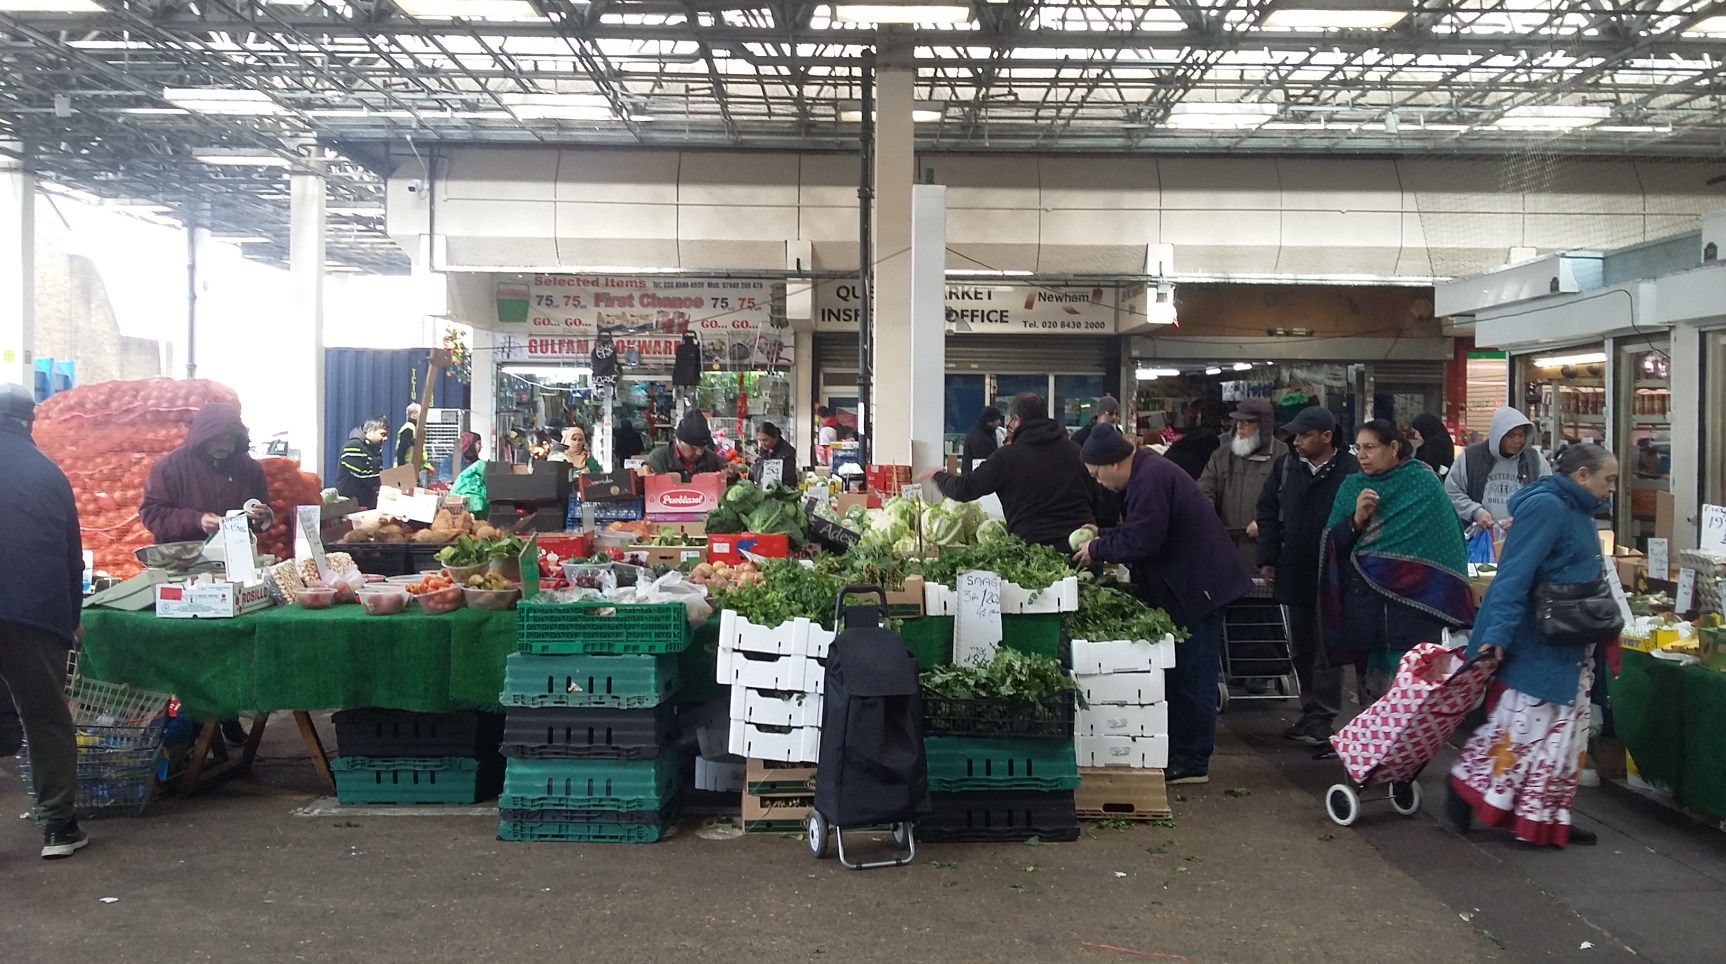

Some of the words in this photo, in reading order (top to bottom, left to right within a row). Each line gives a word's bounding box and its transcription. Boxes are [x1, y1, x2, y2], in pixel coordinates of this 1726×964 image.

[534, 275, 600, 287] Selected
[605, 277, 647, 288] Items
[594, 291, 635, 308] First
[639, 293, 705, 309] Chance
[1038, 291, 1090, 304] Newham
[1023, 320, 1039, 329] Tel.
[1041, 320, 1058, 329] 020
[1060, 321, 1082, 330] 8430
[1084, 321, 1106, 330] 2000
[241, 586, 269, 606] ROSILLO
